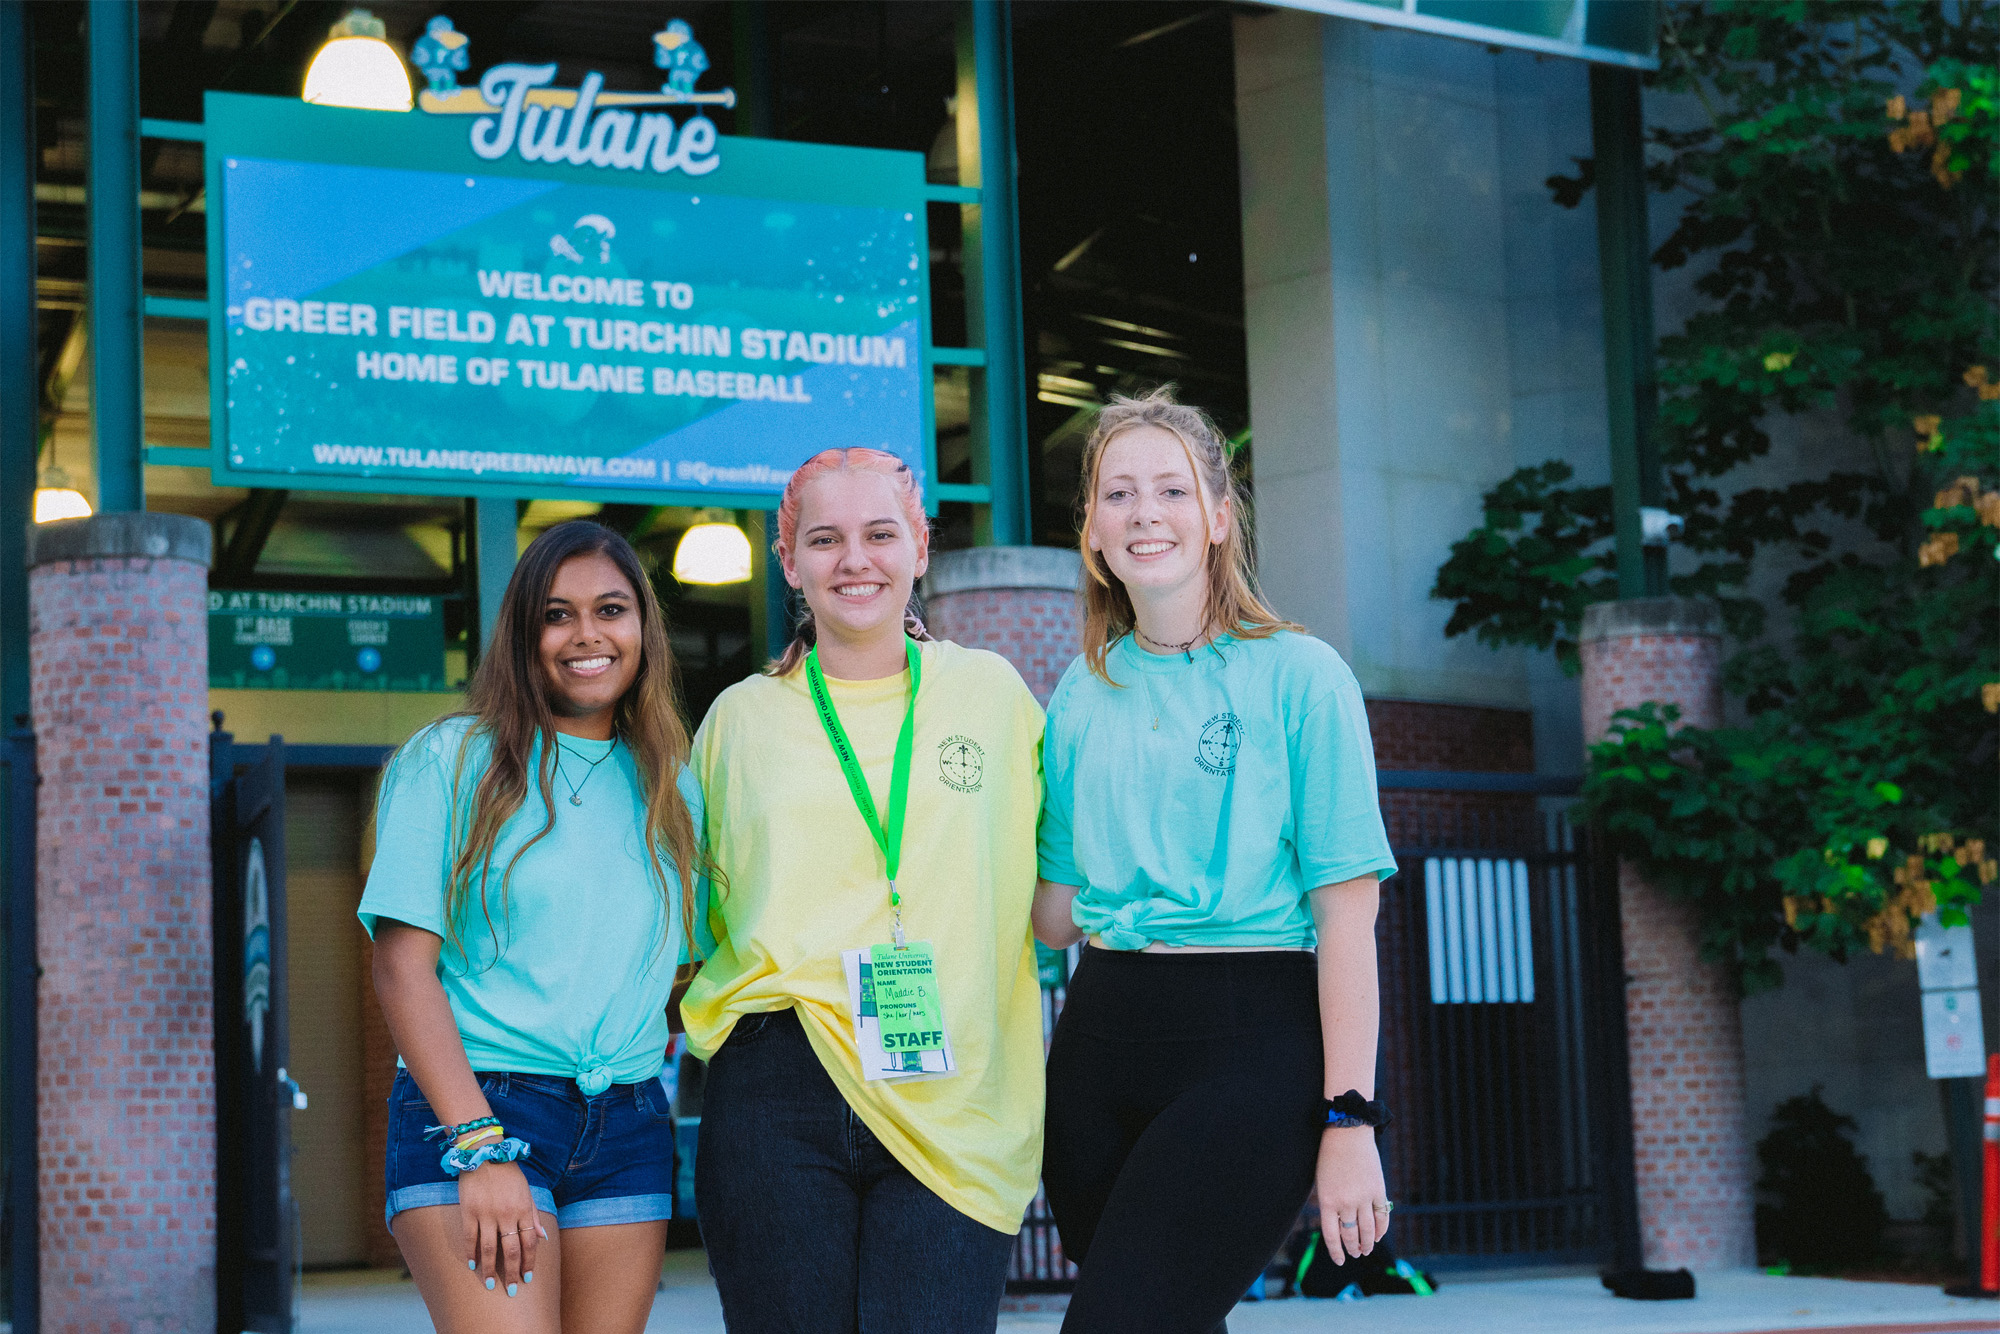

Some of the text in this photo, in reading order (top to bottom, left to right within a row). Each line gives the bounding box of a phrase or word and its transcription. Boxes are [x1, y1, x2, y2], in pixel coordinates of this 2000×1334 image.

[470, 62, 721, 175] Tulane
[478, 269, 694, 310] WELCOME TO
[244, 297, 907, 368] GREER FIELD AT TURCHIN STADIUM
[356, 350, 812, 404] HOME OF TULANE BASEBALL
[312, 443, 656, 479] WWW.TULANEGREENWAVE.COM
[229, 592, 252, 610] AT
[258, 592, 342, 613] TURCHIN
[348, 595, 432, 615] STADIUM
[809, 665, 851, 762] NEW STUDENT ORIENTATION
[1201, 714, 1219, 729] NEW
[938, 735, 985, 756] NEW STUDENT
[874, 959, 933, 969] NEW STUDENT
[877, 967, 933, 976] ORIENTATION
[885, 987, 915, 1000] Maddie
[879, 1002, 917, 1010] PRONOUNS
[883, 1030, 943, 1049] STAFF
